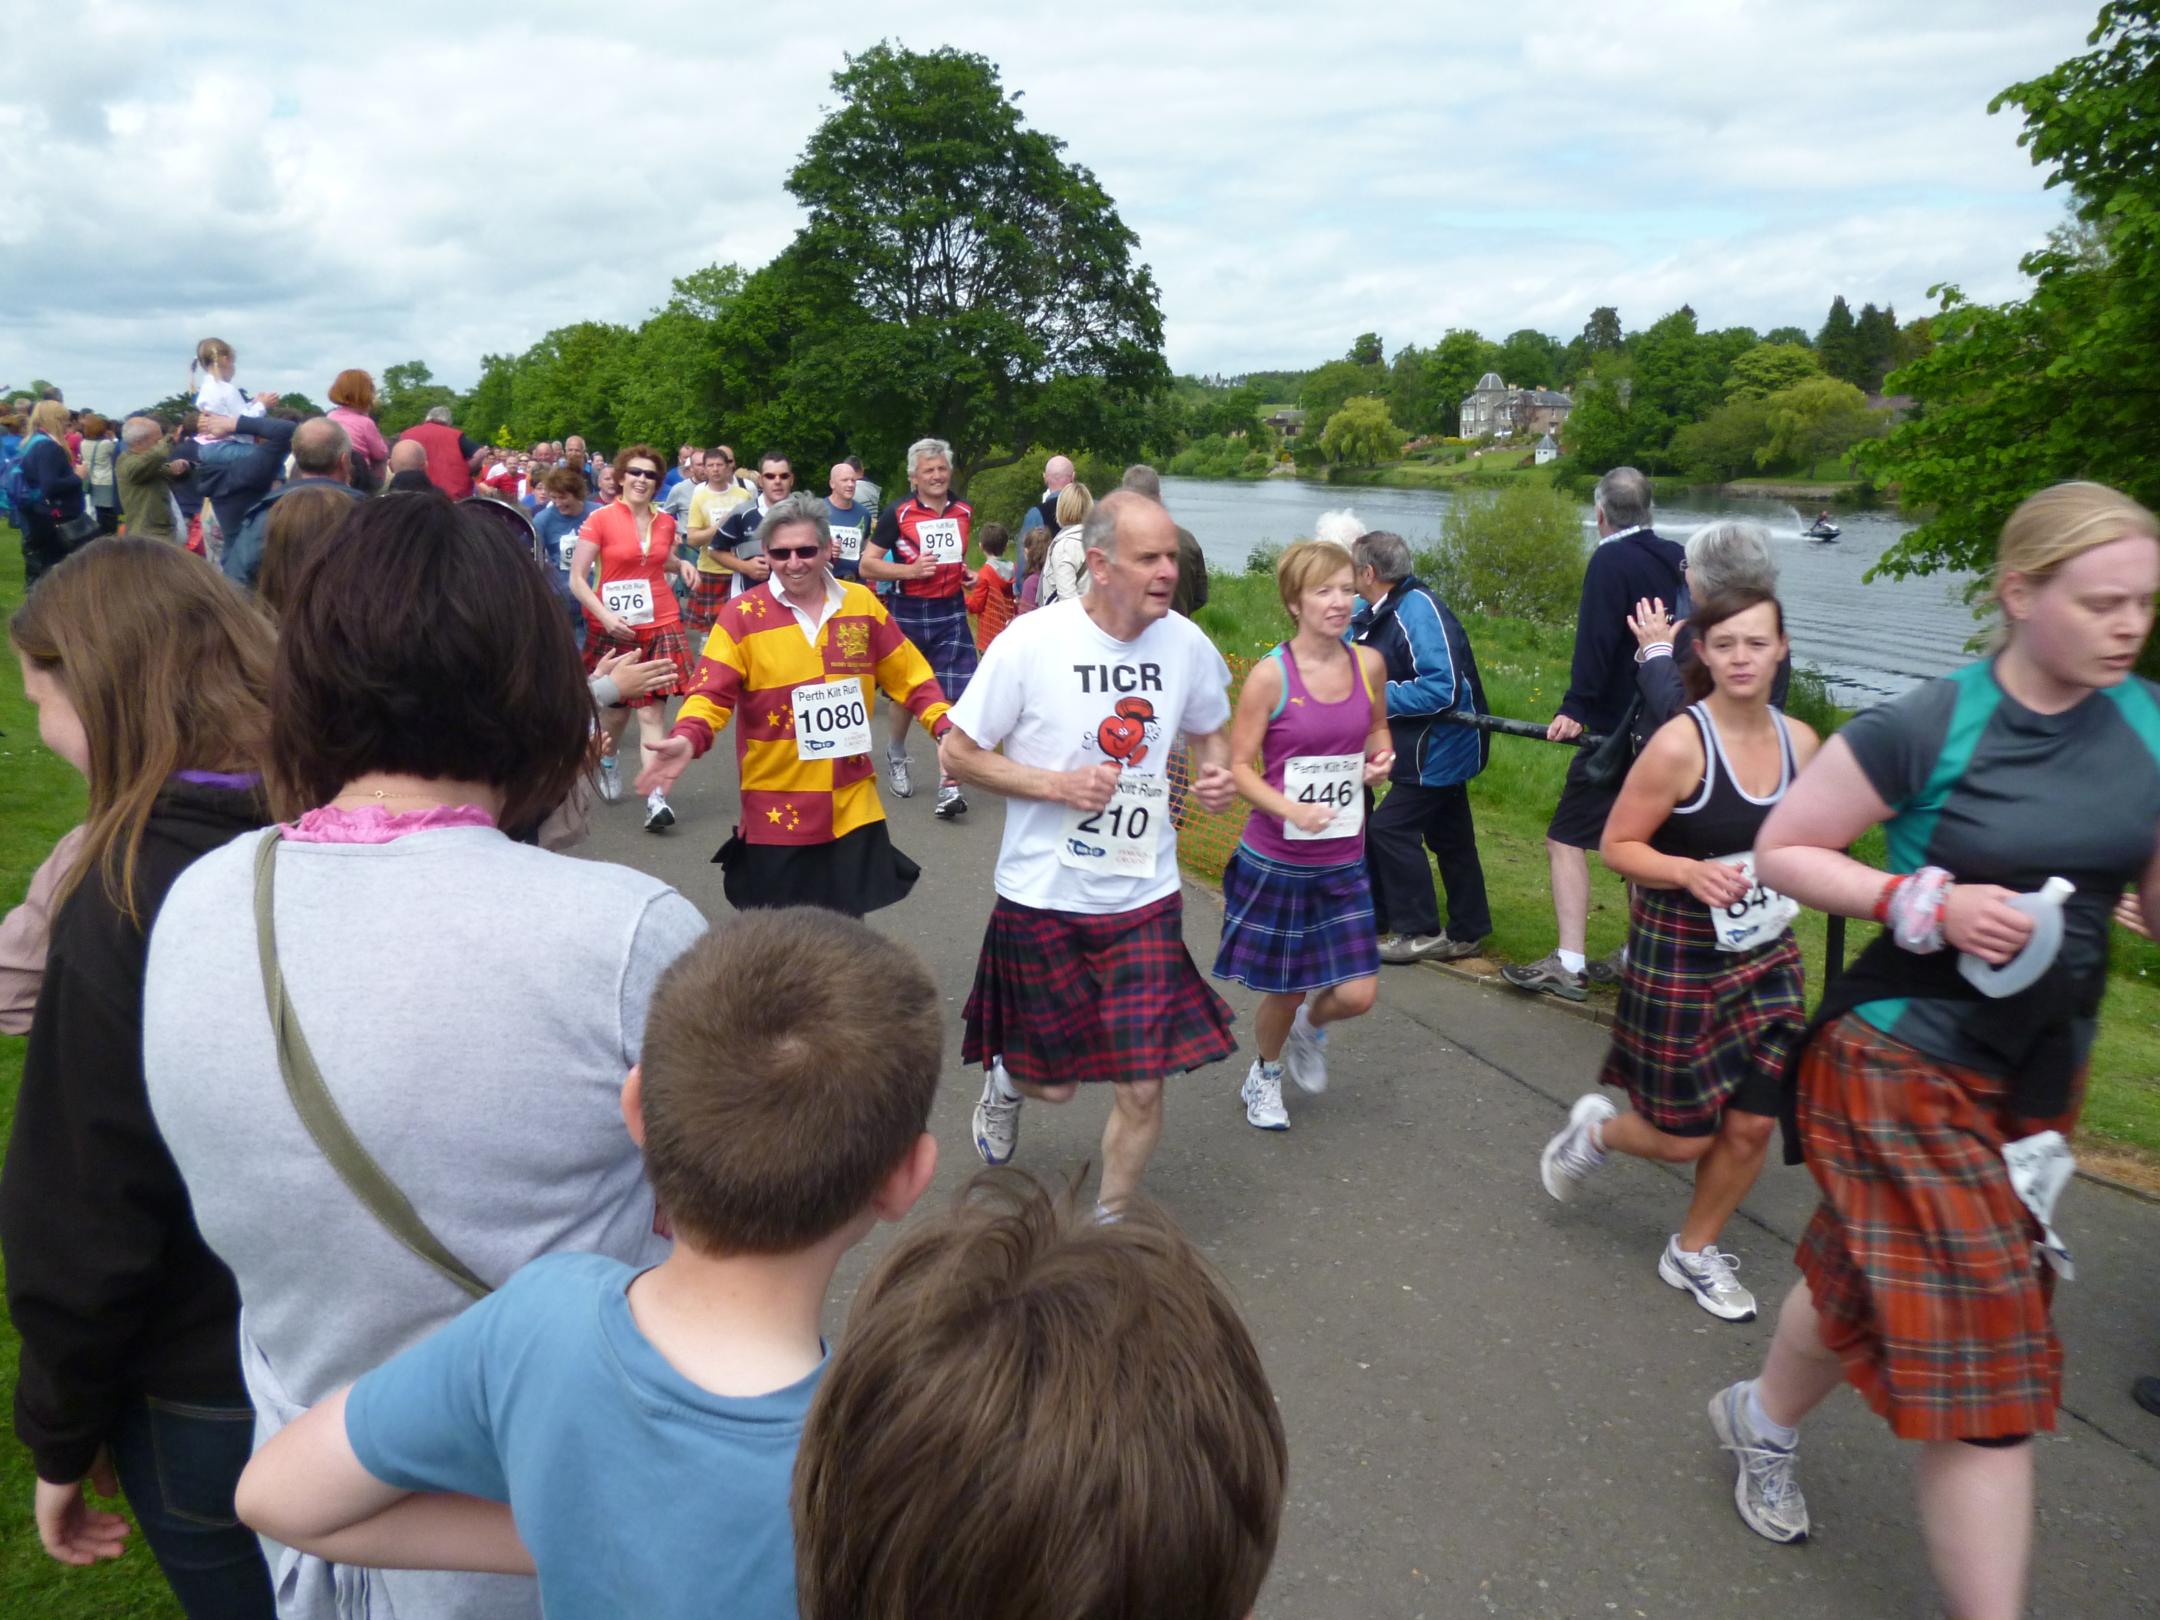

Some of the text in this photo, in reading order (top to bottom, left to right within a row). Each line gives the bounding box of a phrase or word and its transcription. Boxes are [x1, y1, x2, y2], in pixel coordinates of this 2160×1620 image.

[926, 533, 955, 549] 978
[609, 594, 644, 611] 976
[1073, 663, 1163, 693] TICR
[798, 685, 858, 702] Perth Kilt Run
[798, 701, 865, 733] 1080
[1343, 760, 1359, 771] Run
[1139, 783, 1163, 798] Run
[1298, 780, 1353, 808] 446
[1077, 805, 1149, 839] 210
